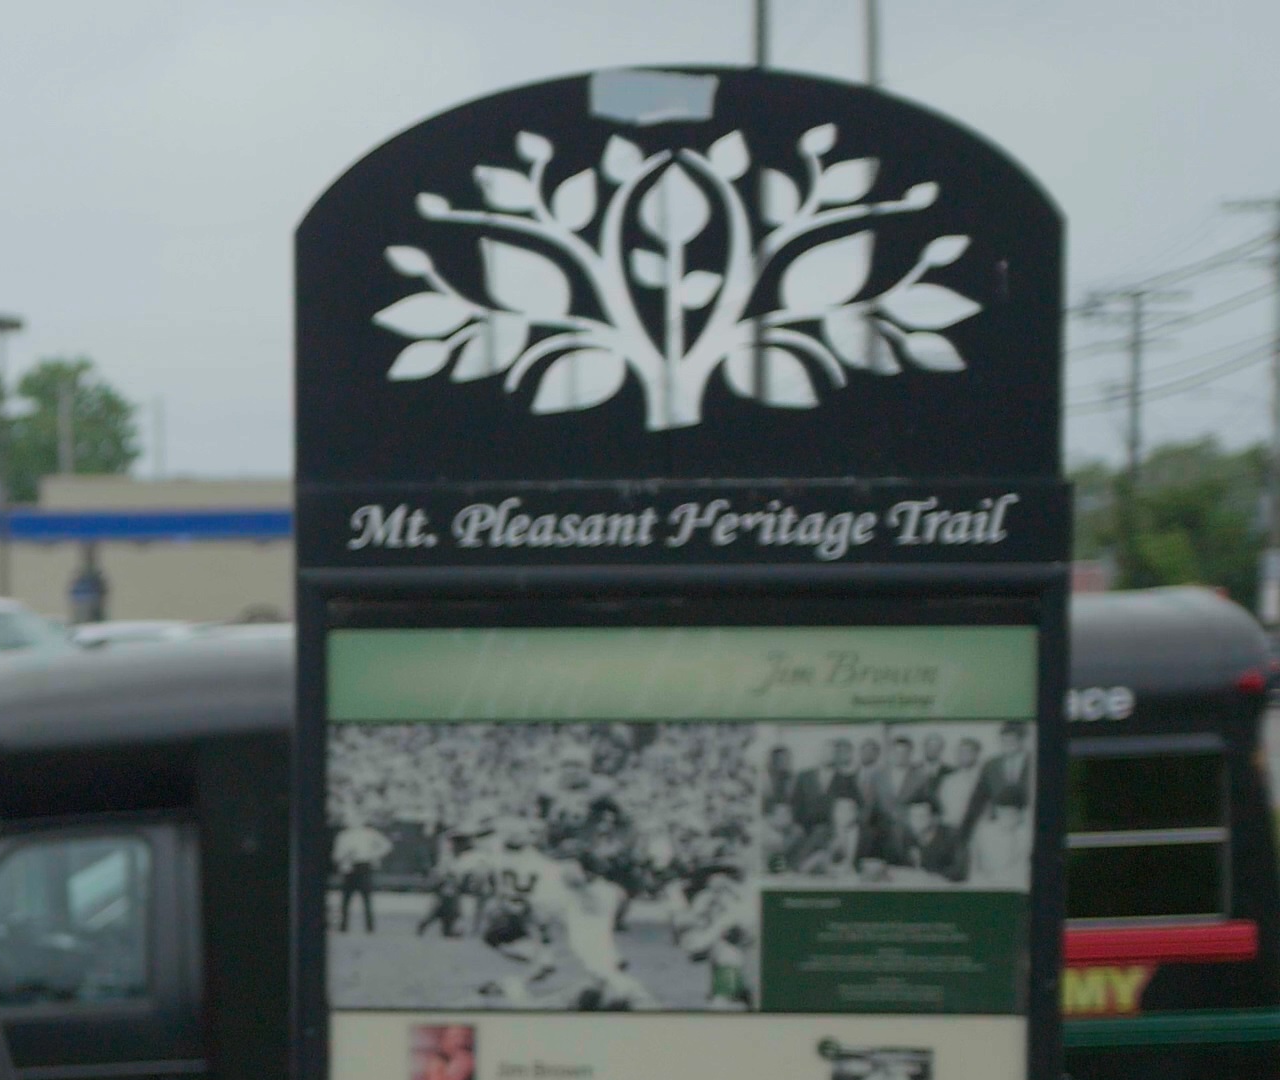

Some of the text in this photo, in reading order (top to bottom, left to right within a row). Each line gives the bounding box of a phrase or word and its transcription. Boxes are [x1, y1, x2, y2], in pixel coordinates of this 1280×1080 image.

[348, 493, 1020, 558] Mt. Pleasant Heritage Trail
